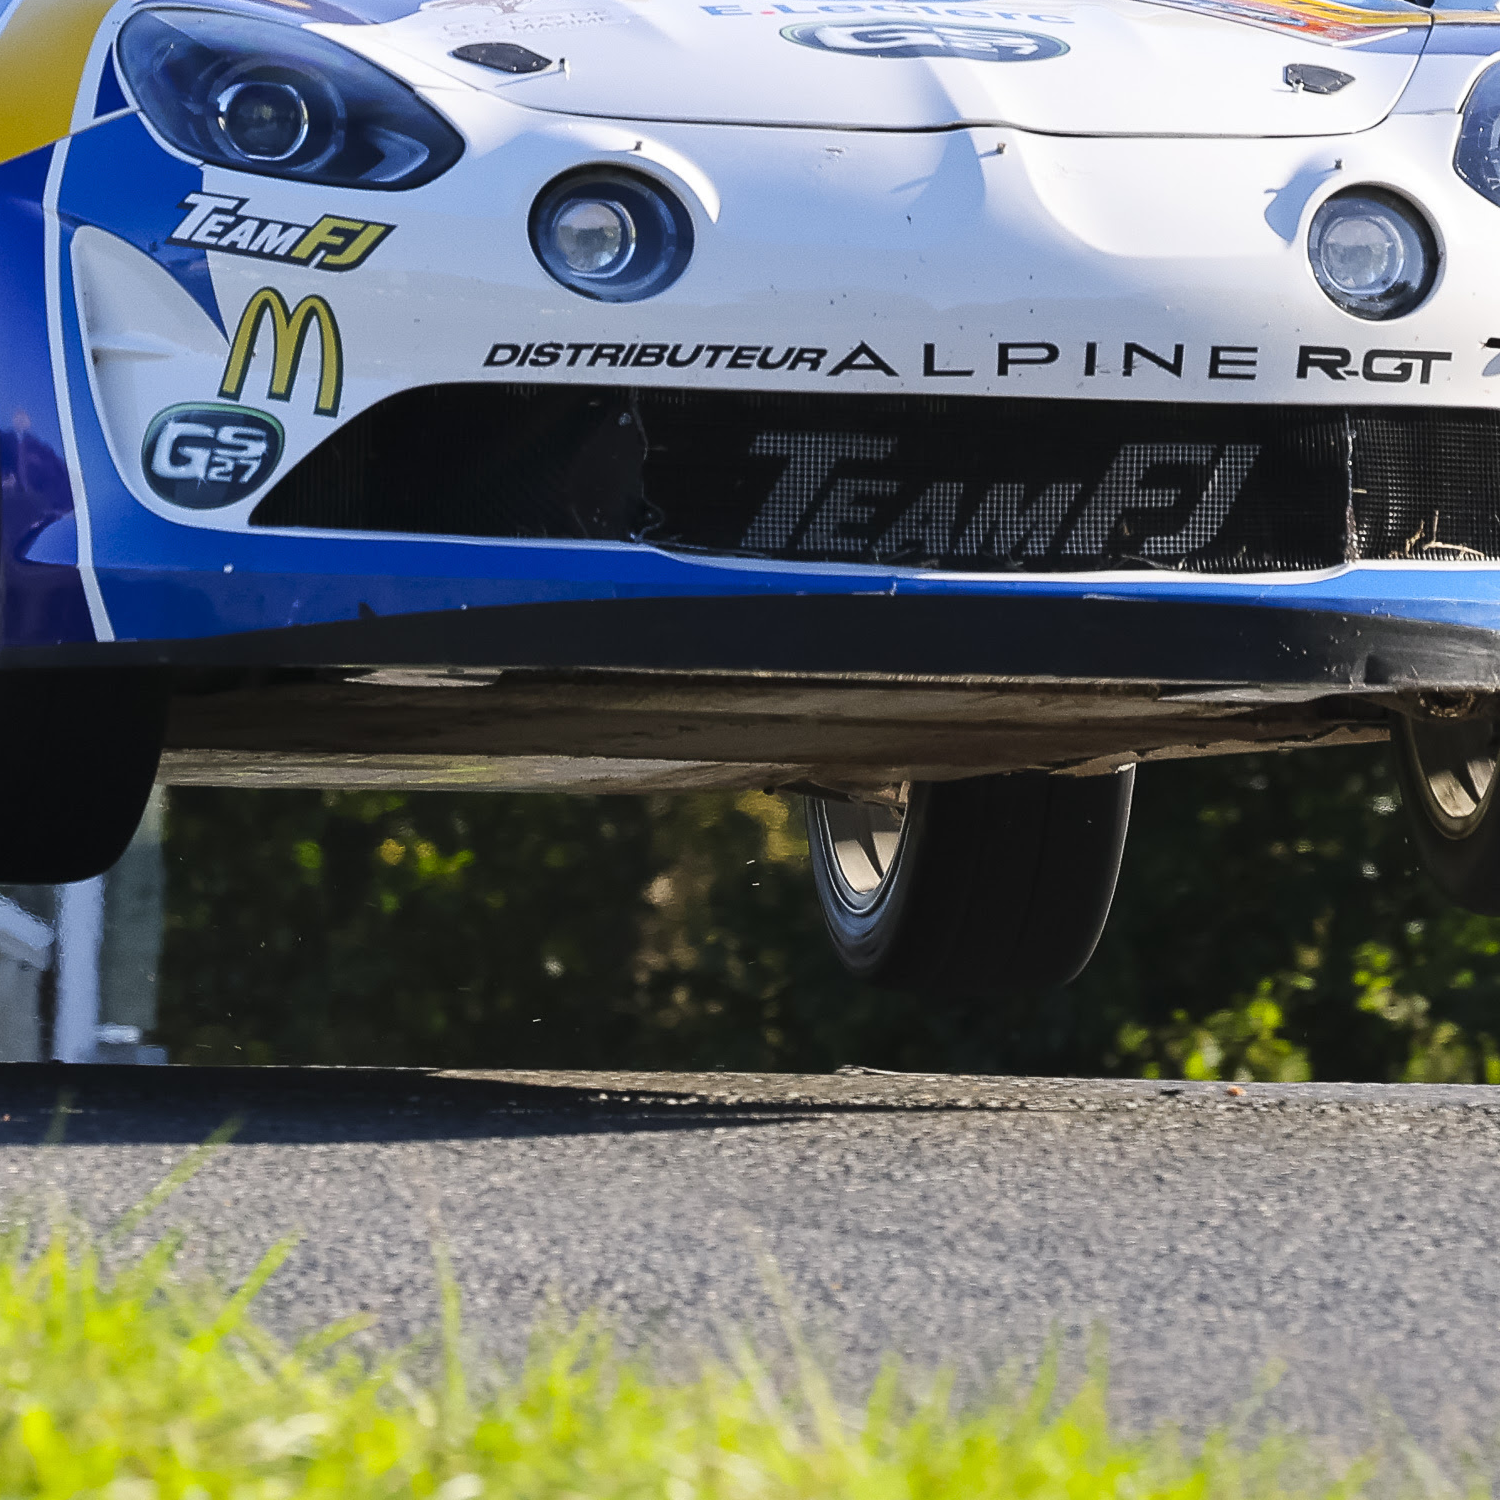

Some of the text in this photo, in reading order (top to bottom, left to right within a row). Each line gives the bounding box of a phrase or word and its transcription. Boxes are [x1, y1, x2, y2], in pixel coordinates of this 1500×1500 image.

[699, 2, 1076, 25] E.Leclerc
[169, 192, 393, 269] TEAMFJ
[484, 342, 828, 372] DISTRIBUTEUR
[827, 341, 1258, 380] ALPINE
